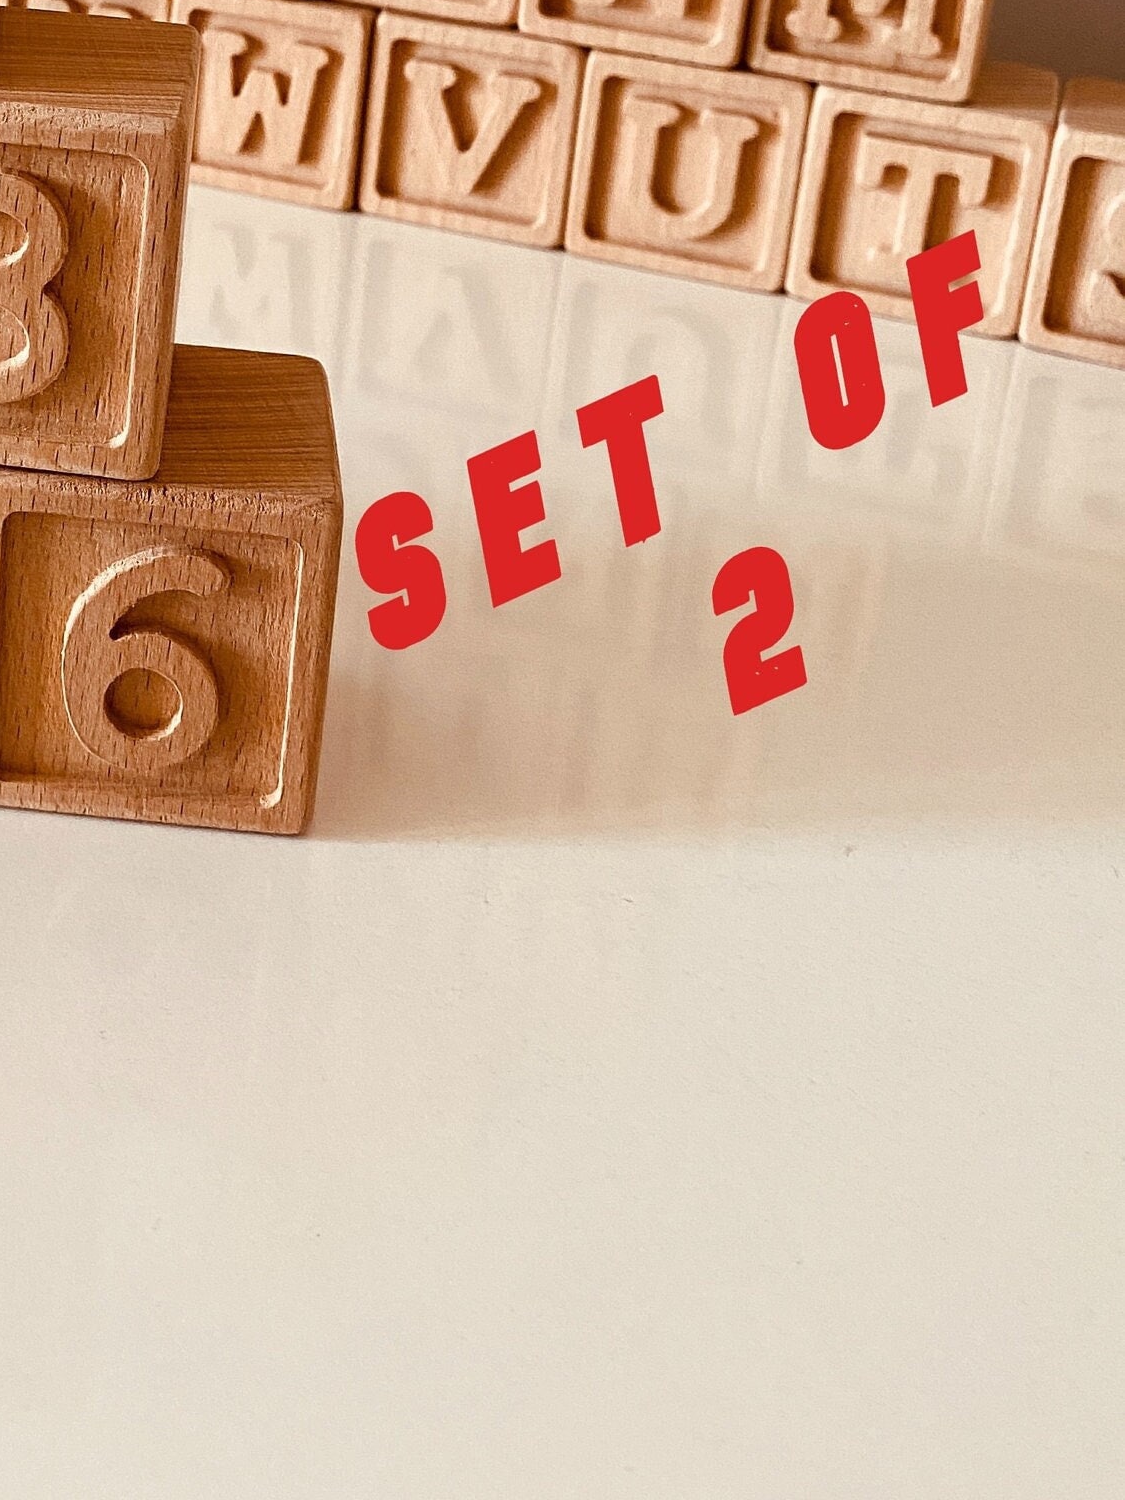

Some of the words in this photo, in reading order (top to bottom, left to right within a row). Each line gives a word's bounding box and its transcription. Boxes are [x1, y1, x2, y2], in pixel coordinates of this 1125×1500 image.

[201, 30, 330, 164] W
[405, 60, 540, 194] V
[617, 96, 759, 240] U
[855, 130, 992, 260] T
[61, 547, 232, 771] 6
